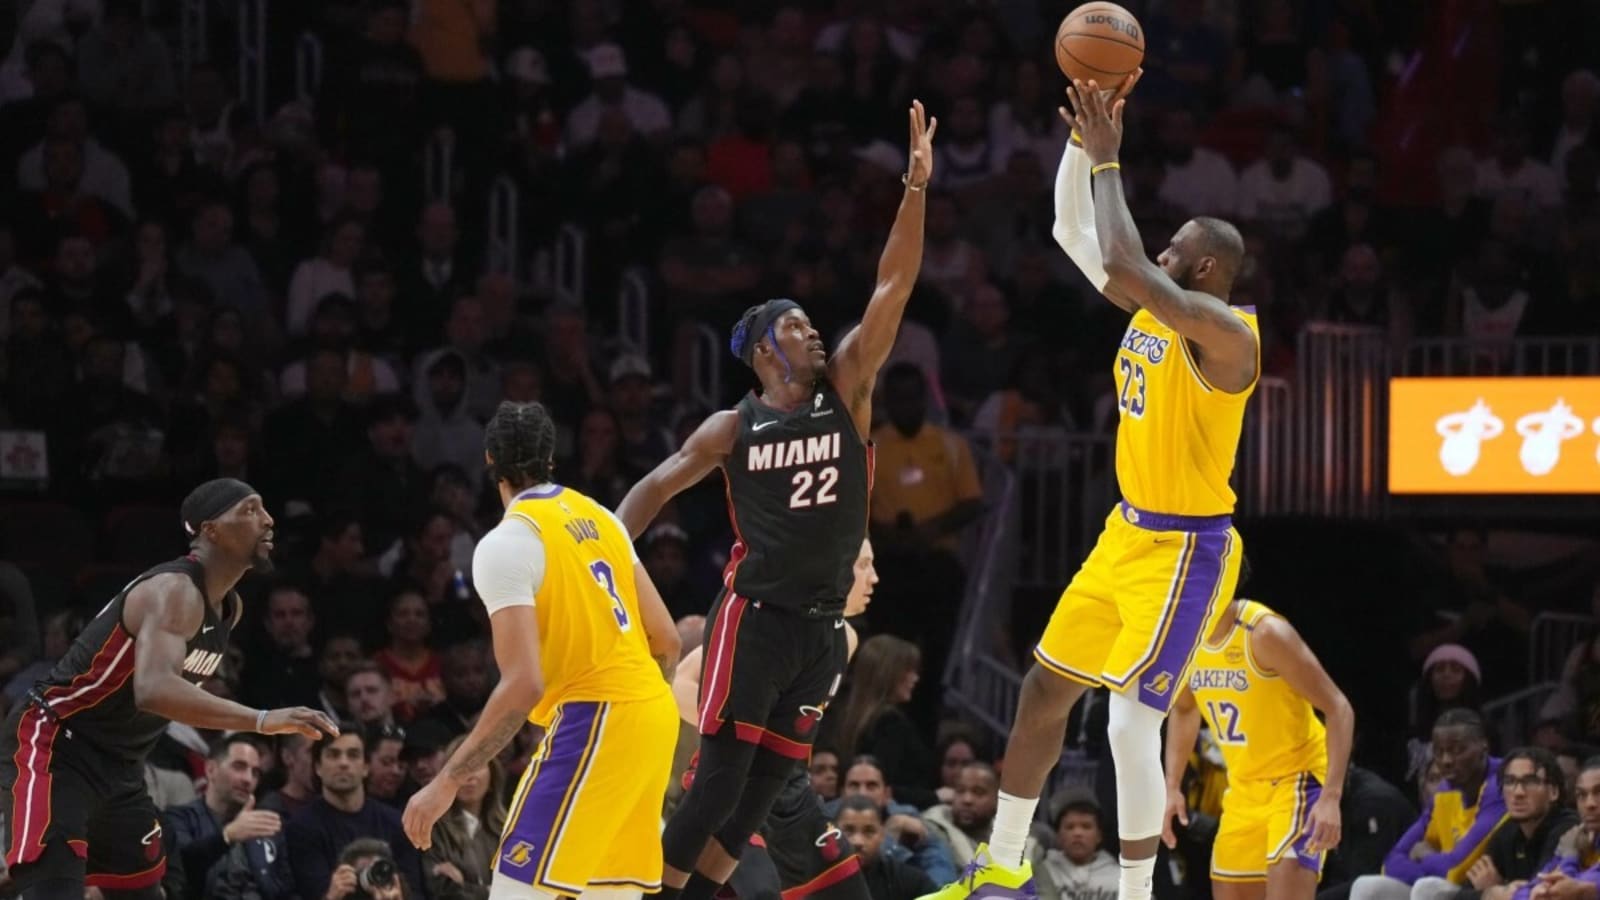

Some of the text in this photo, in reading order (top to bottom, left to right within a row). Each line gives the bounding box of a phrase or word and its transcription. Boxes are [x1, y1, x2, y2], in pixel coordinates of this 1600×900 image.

[1085, 15, 1138, 40] Wilson
[1120, 355, 1146, 416] 23
[747, 432, 841, 472] MIAMI
[789, 466, 839, 509] 22
[588, 559, 630, 630] 3
[1190, 668, 1249, 692] AKERS
[1206, 700, 1246, 743] 12
